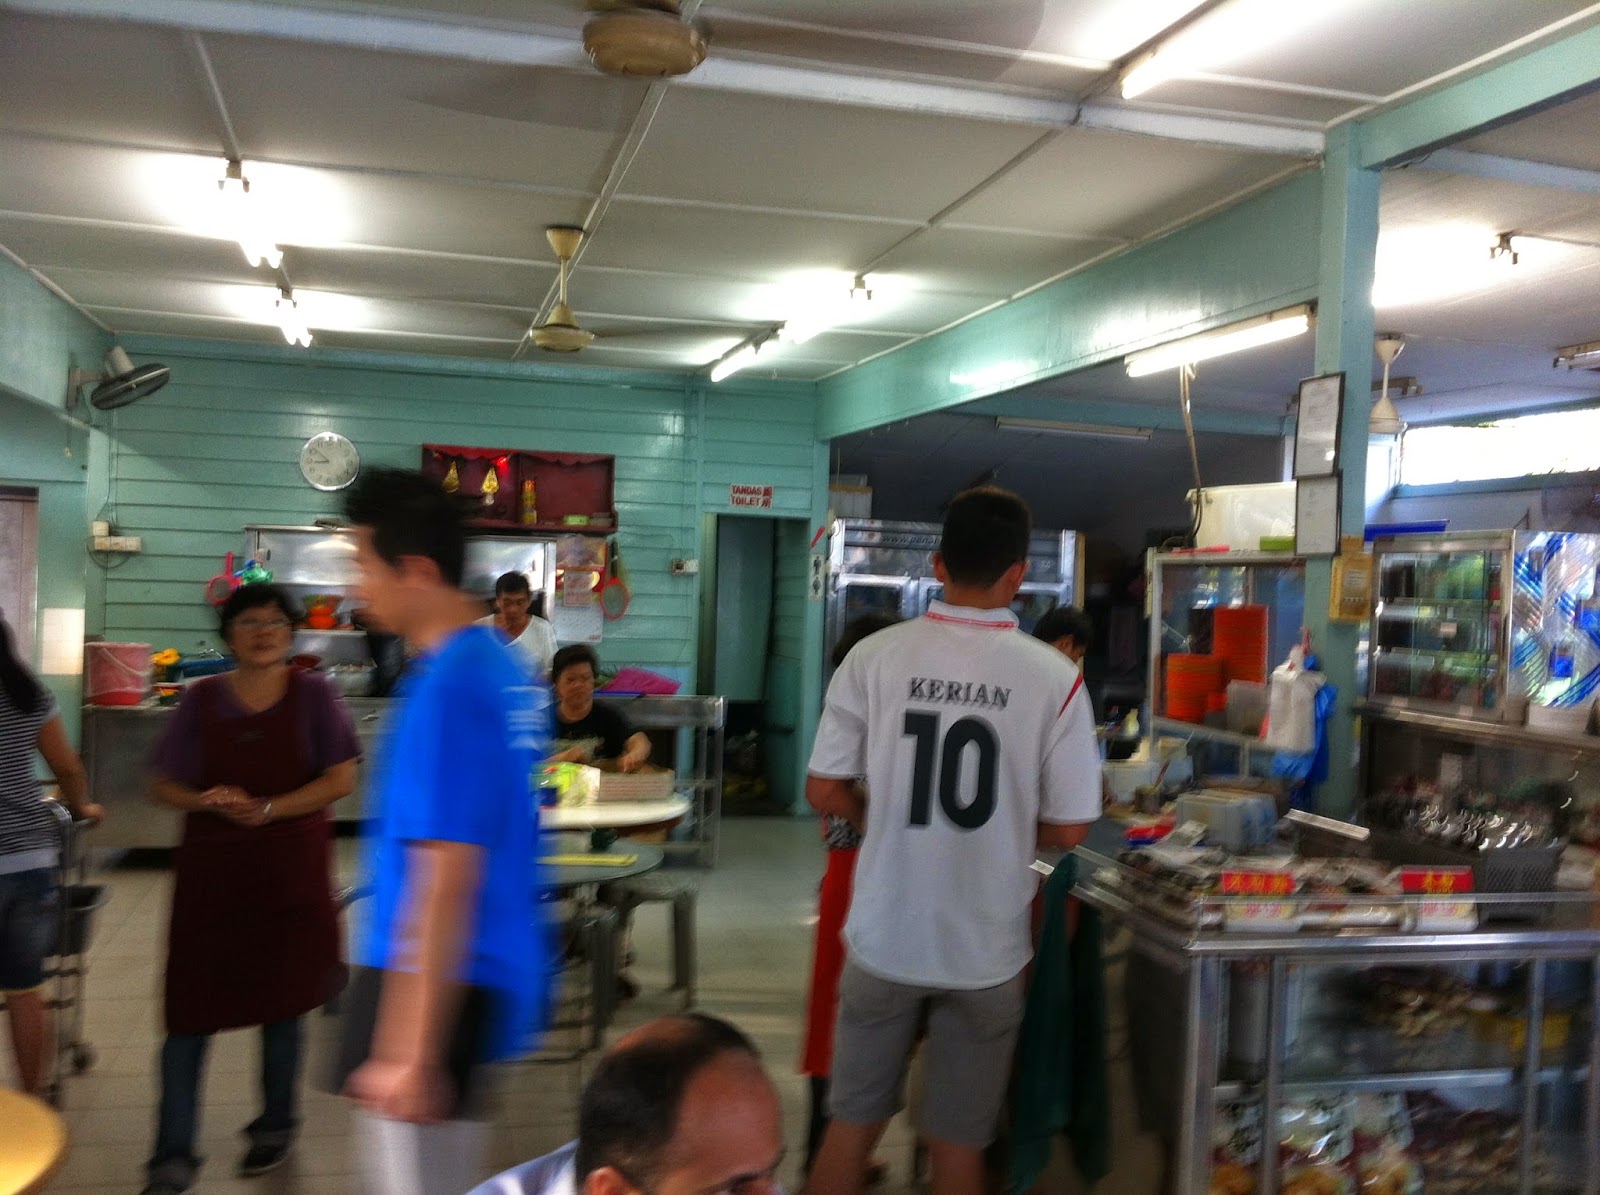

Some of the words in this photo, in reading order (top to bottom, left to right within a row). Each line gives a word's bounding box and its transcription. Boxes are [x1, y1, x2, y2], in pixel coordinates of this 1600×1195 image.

[731, 485, 762, 496] TANDAS
[731, 495, 761, 506] TOILET
[908, 677, 1012, 709] KERIAN
[903, 709, 1001, 830] 10
